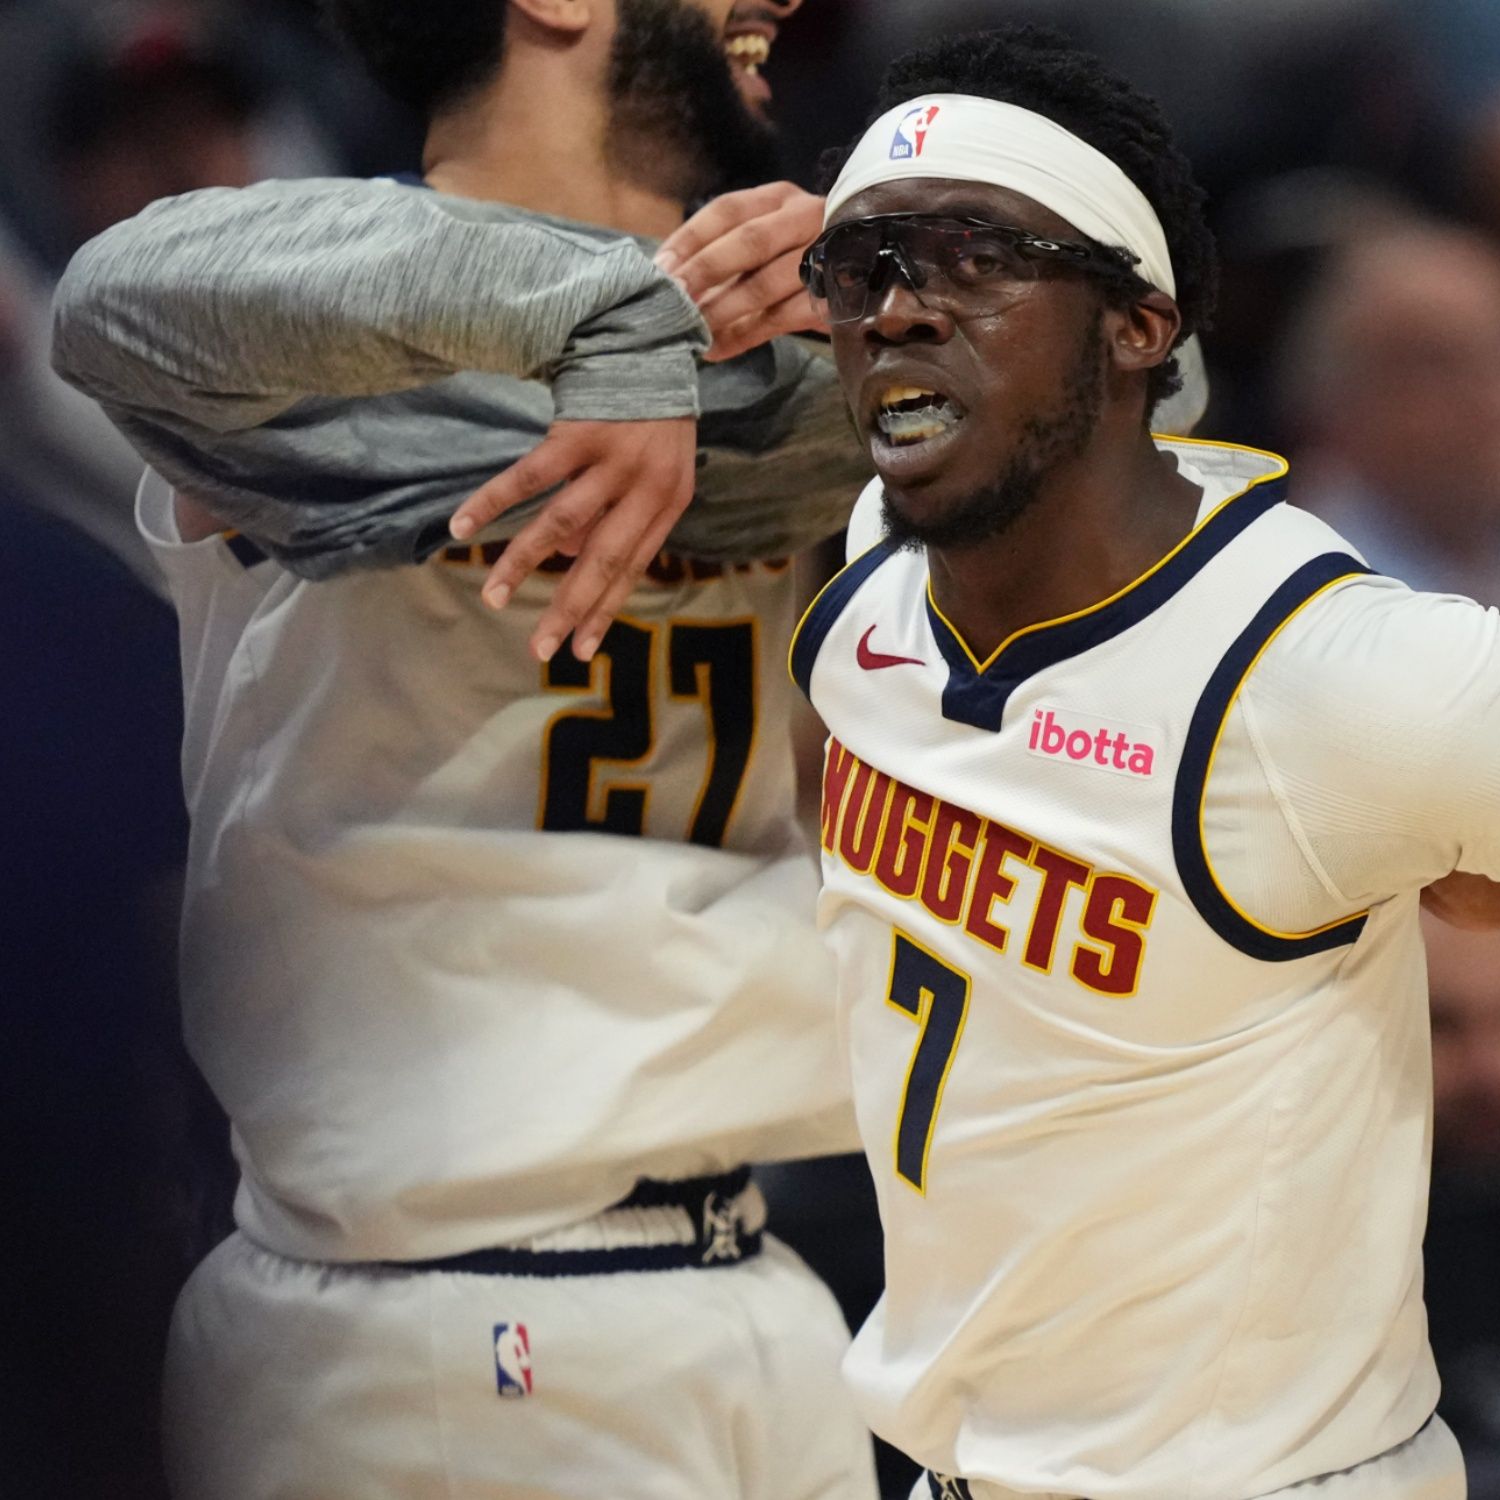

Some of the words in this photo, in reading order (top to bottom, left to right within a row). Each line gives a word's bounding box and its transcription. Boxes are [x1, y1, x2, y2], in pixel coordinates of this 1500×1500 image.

[536, 613, 761, 848] 27
[1029, 709, 1154, 776] ibotta
[885, 923, 973, 1199] 7
